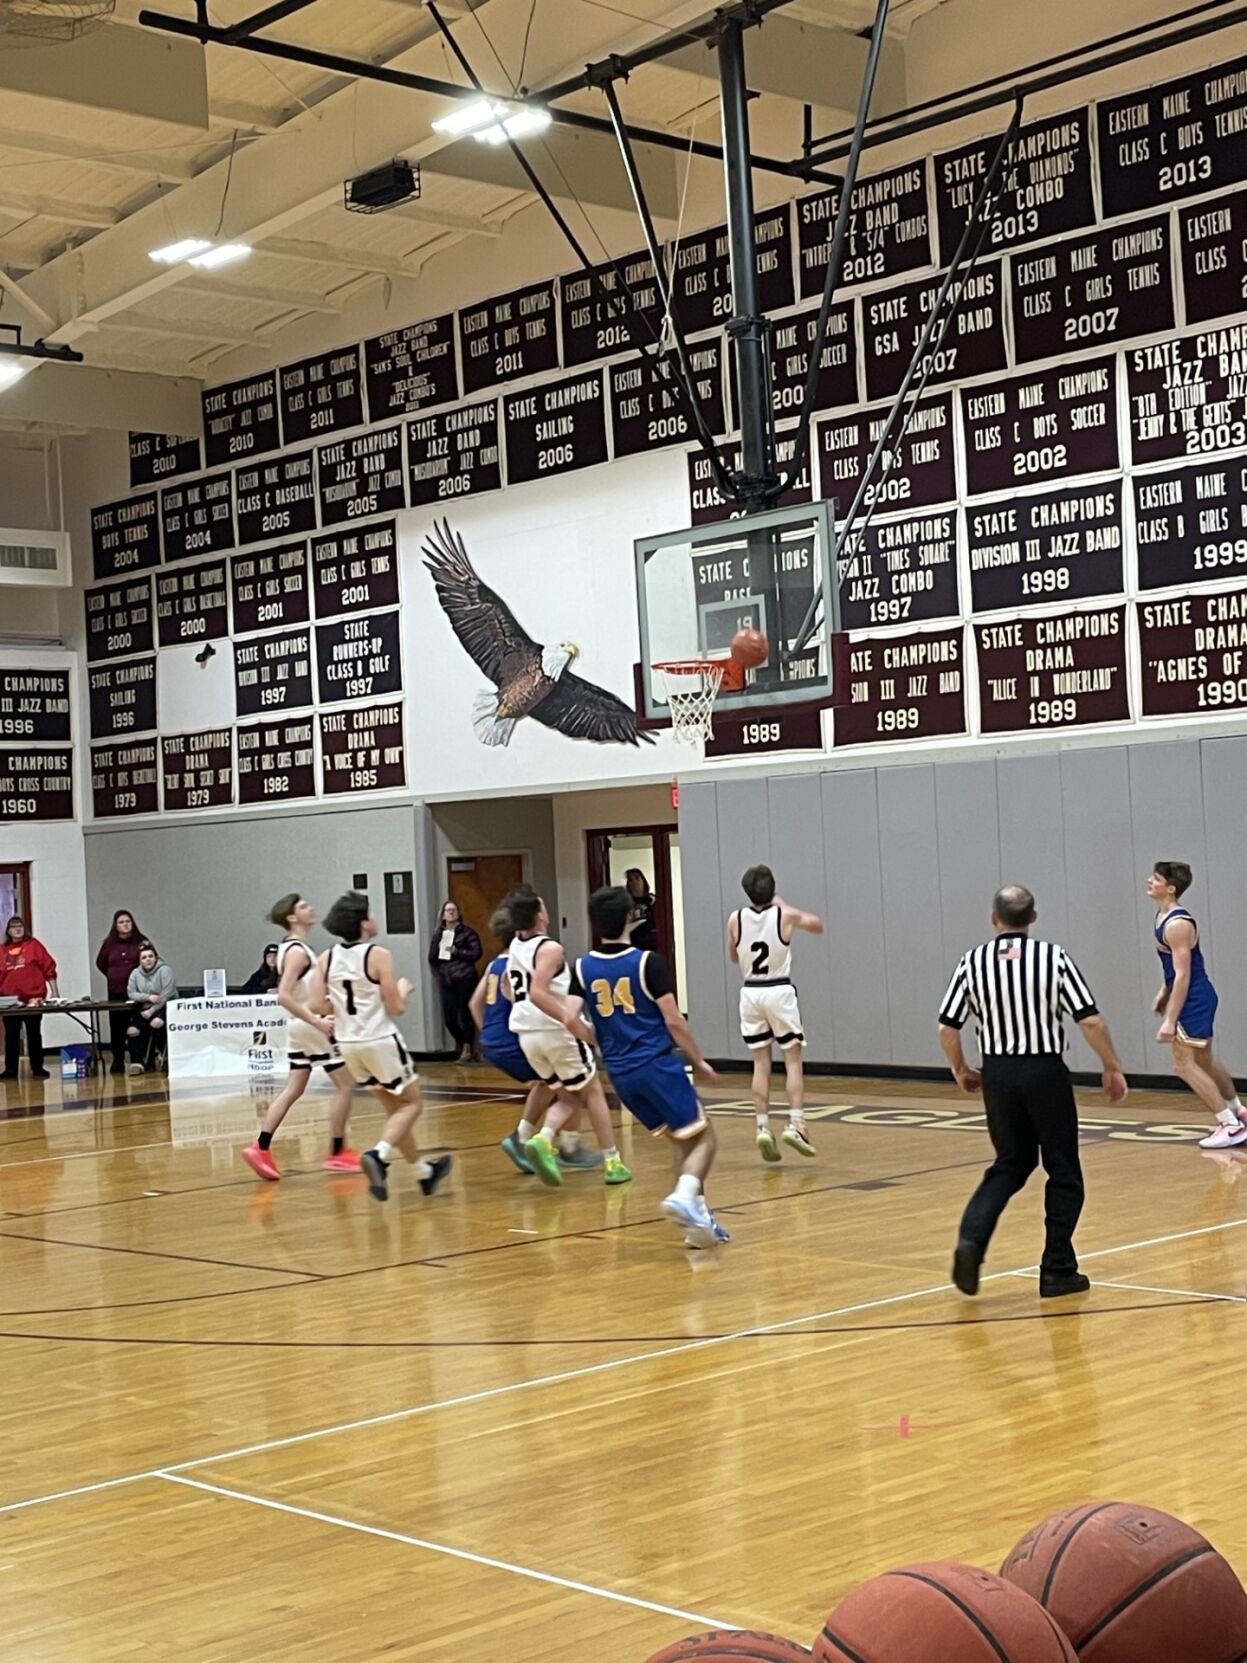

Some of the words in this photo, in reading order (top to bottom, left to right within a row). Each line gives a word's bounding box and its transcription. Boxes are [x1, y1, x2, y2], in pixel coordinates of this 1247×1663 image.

[1109, 103, 1149, 135] EASTERN
[1163, 90, 1190, 120] MAINE
[1119, 138, 1149, 166] CLASS
[1161, 132, 1168, 155] C
[1178, 121, 1203, 150] BOYS
[944, 151, 986, 184] STATE
[1158, 155, 1212, 191] 2013
[803, 195, 839, 224] STATE
[850, 170, 921, 210] CHAMPIONS
[1016, 177, 1063, 210] COMBO
[866, 202, 899, 236] BAND
[991, 210, 1039, 243] 2013
[1187, 208, 1231, 242] EASTERN
[843, 252, 886, 281] 2012
[1018, 256, 1056, 286] EASTERN
[1070, 244, 1098, 273] MAINE
[1112, 227, 1163, 261] CHAMPIONS
[1195, 246, 1227, 275] CLASS
[685, 272, 706, 296] CLASS
[1023, 291, 1051, 318] CLASS
[1064, 285, 1071, 307] C
[1086, 274, 1112, 303] GIRLS
[1127, 262, 1160, 291] TENNIS
[870, 296, 908, 325] STATE
[875, 331, 900, 356] GSA
[958, 306, 993, 335] BAND
[1064, 307, 1119, 341] 2007
[470, 336, 488, 357] CLASS
[1134, 340, 1182, 372] STATE
[495, 352, 523, 378] 2011
[1162, 360, 1204, 389] JAZZ
[205, 392, 226, 413] STATE
[508, 396, 537, 420] STATE
[544, 380, 600, 411] CHAMPIONS
[967, 392, 1005, 420] EASTERN
[1018, 383, 1045, 410] MAINE
[1058, 367, 1108, 400] CHAMPIONS
[310, 408, 334, 429] 2011
[620, 397, 640, 419] CLASS
[1180, 407, 1199, 432] THE
[410, 419, 437, 445] STATE
[446, 403, 495, 432] CHAMPIONS
[535, 415, 574, 441] SAILING
[648, 415, 688, 440] 2006
[975, 425, 1001, 451] CLASS
[1013, 421, 1020, 443] C
[1033, 413, 1058, 439] BOYS
[1070, 402, 1106, 431] SOCCER
[229, 432, 254, 454] 2010
[427, 437, 449, 458] JAZZ
[825, 425, 859, 452] EASTERN
[1186, 421, 1246, 454] 2003
[152, 454, 176, 474] 2010
[321, 444, 346, 466] STATE
[538, 444, 574, 470] 2006
[1013, 443, 1067, 475] 2002
[336, 460, 357, 481] JAZZ
[833, 456, 859, 480] CLASS
[438, 474, 470, 497] 2006
[1139, 480, 1183, 510] EASTERN
[1195, 472, 1227, 500] MAINE
[238, 494, 260, 514] CLASS
[347, 495, 378, 516] 2005
[973, 509, 1018, 538] STATE
[1030, 493, 1115, 528] CHAMPIONS
[262, 510, 290, 532] 2005
[878, 517, 950, 549] CHAMPIONS
[1137, 516, 1169, 546] CLASS
[1199, 507, 1229, 534] GIRLS
[185, 529, 211, 550] 2004
[971, 540, 1020, 571] DIVISION
[1025, 539, 1041, 563] III
[1047, 532, 1080, 558] JAZZ
[1086, 525, 1121, 553] BAND
[114, 548, 139, 568] 2004
[699, 561, 733, 585] STATE
[848, 577, 880, 602] JAZZ
[891, 569, 934, 595] COMBO
[1021, 567, 1070, 595] 1998
[341, 584, 370, 606] 2001
[258, 602, 283, 622] 2001
[869, 595, 912, 623] 1997
[1143, 601, 1192, 628] STATE
[180, 617, 206, 637] 2000
[344, 620, 370, 641] STATE
[981, 623, 1024, 650] STATE
[1036, 612, 1120, 644] CHAMPIONS
[107, 632, 132, 651] 2000
[237, 645, 260, 665] STATE
[883, 639, 958, 670] CHAMPIONS
[1025, 645, 1075, 672] DRAMA
[1223, 651, 1242, 676] OF
[326, 661, 353, 681] CLASS
[4, 676, 64, 692] CHAMPIONS
[260, 686, 286, 706] 1997
[345, 677, 373, 697] 1997
[907, 675, 928, 698] JAZZ
[18, 698, 42, 713] JAZZ
[1029, 699, 1077, 725] 1989
[112, 710, 135, 729] 1996
[322, 714, 346, 733] STATE
[353, 707, 399, 730] CHAMPIONS
[876, 708, 920, 732] 1989
[163, 737, 185, 754] STATE
[742, 723, 781, 745] 1989
[8, 756, 68, 771] CHAMPIONS
[263, 776, 289, 794] 1982
[350, 769, 377, 788] 1985
[2, 798, 37, 814] 1960
[114, 792, 137, 809] 1979
[187, 789, 209, 807] 1979
[751, 941, 769, 975] 2
[177, 1001, 202, 1011] First
[205, 998, 252, 1010] National
[342, 979, 357, 1016] 1
[591, 976, 636, 1017] 34
[168, 1022, 208, 1031] George
[211, 1020, 253, 1030] Stevens
[248, 1049, 273, 1060] First
